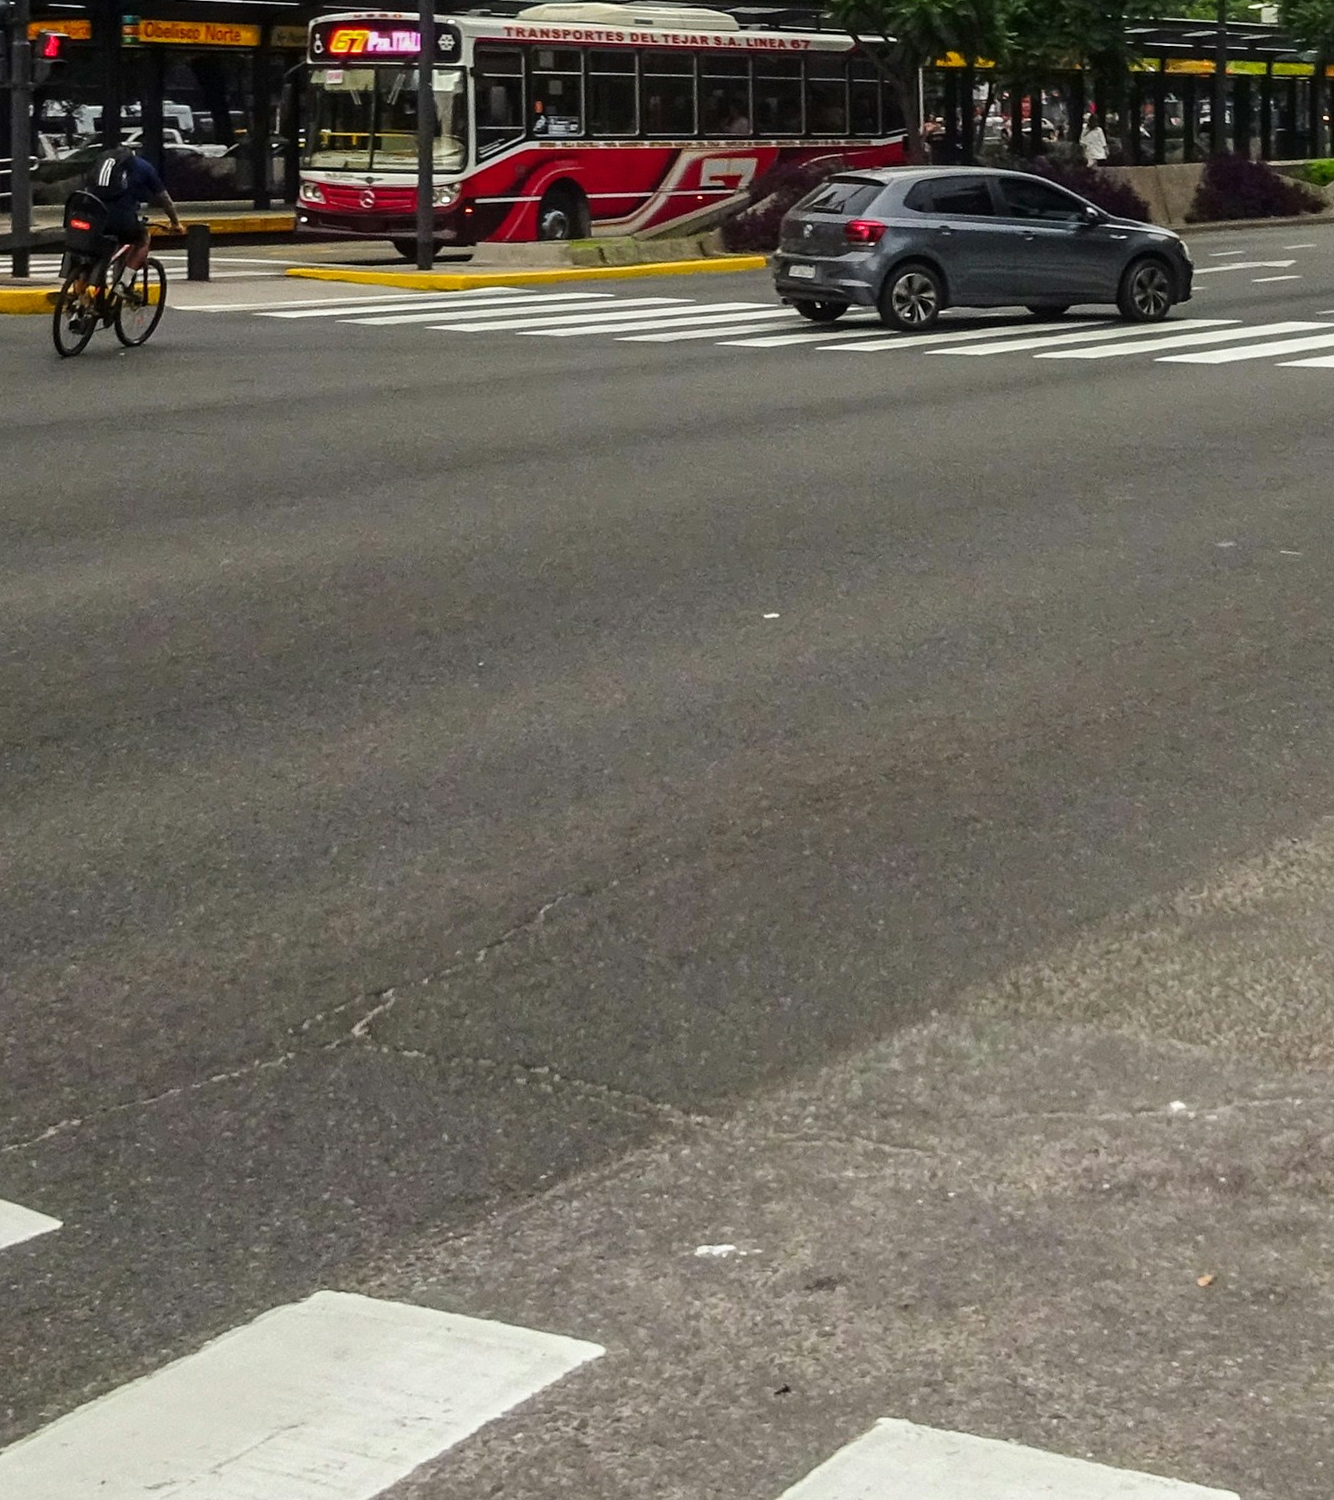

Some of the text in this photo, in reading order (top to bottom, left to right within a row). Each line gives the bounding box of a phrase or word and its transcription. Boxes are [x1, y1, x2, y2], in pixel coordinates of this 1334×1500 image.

[144, 22, 242, 42] Obelisco Norte
[330, 30, 369, 53] 67
[503, 26, 811, 49] TRANSPORTES DEL TEJAR S.A. LINEA 67
